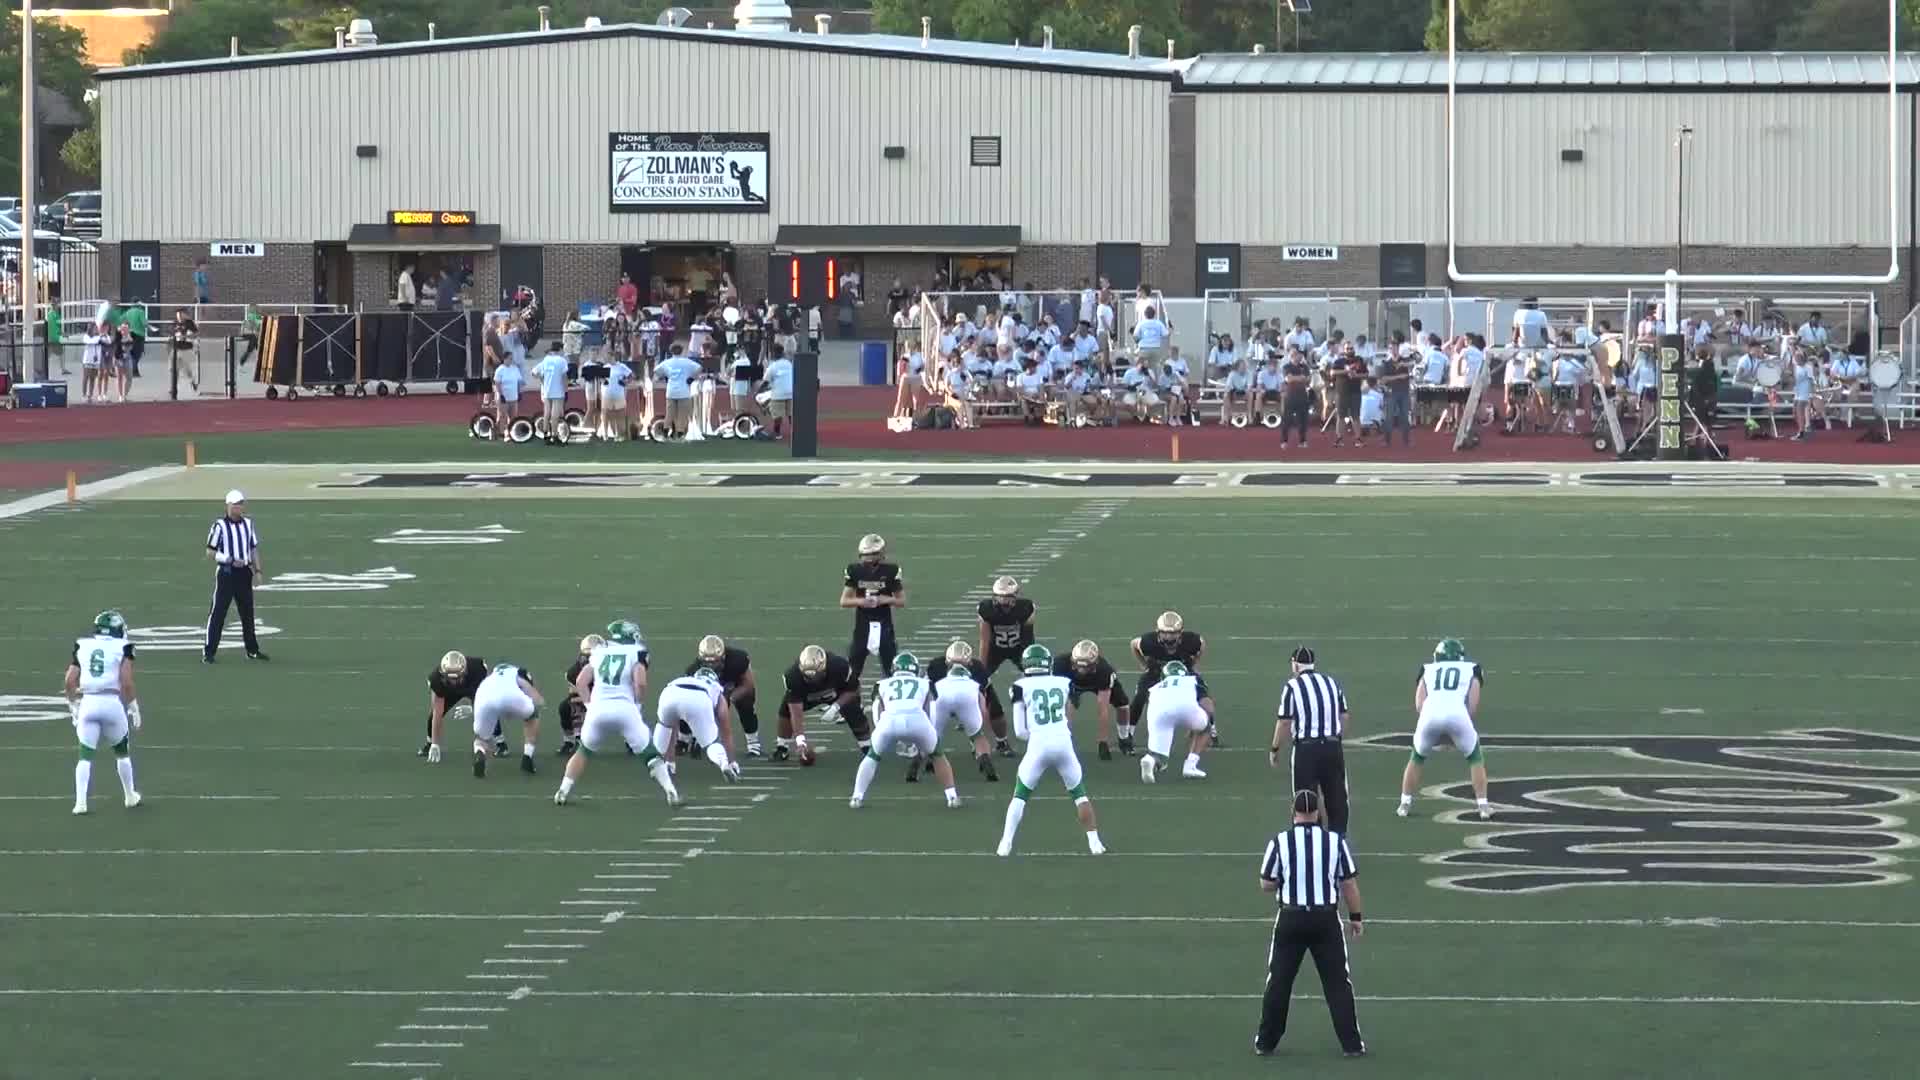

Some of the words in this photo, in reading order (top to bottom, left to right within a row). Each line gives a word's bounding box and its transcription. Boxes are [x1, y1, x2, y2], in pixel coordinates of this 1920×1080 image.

[618, 134, 648, 142] HOME
[615, 143, 630, 151] OF
[631, 143, 651, 151] THE
[646, 156, 725, 174] ZOLMAN'S
[647, 175, 665, 184] TIRE
[668, 175, 675, 184] &
[677, 175, 700, 184] AUTO
[702, 175, 724, 184] CARE
[614, 186, 696, 198] CONCESSION
[698, 186, 740, 198] STAND
[220, 244, 255, 254] MEN
[1288, 247, 1333, 258] WOMEN
[1660, 347, 1680, 449] PENN
[317, 472, 1920, 488] KINGS
[995, 631, 1020, 648] 22
[89, 649, 105, 678] 6
[598, 654, 627, 686] 47
[1433, 667, 1461, 691] 10
[889, 679, 919, 701] 37
[1032, 687, 1064, 725] 32
